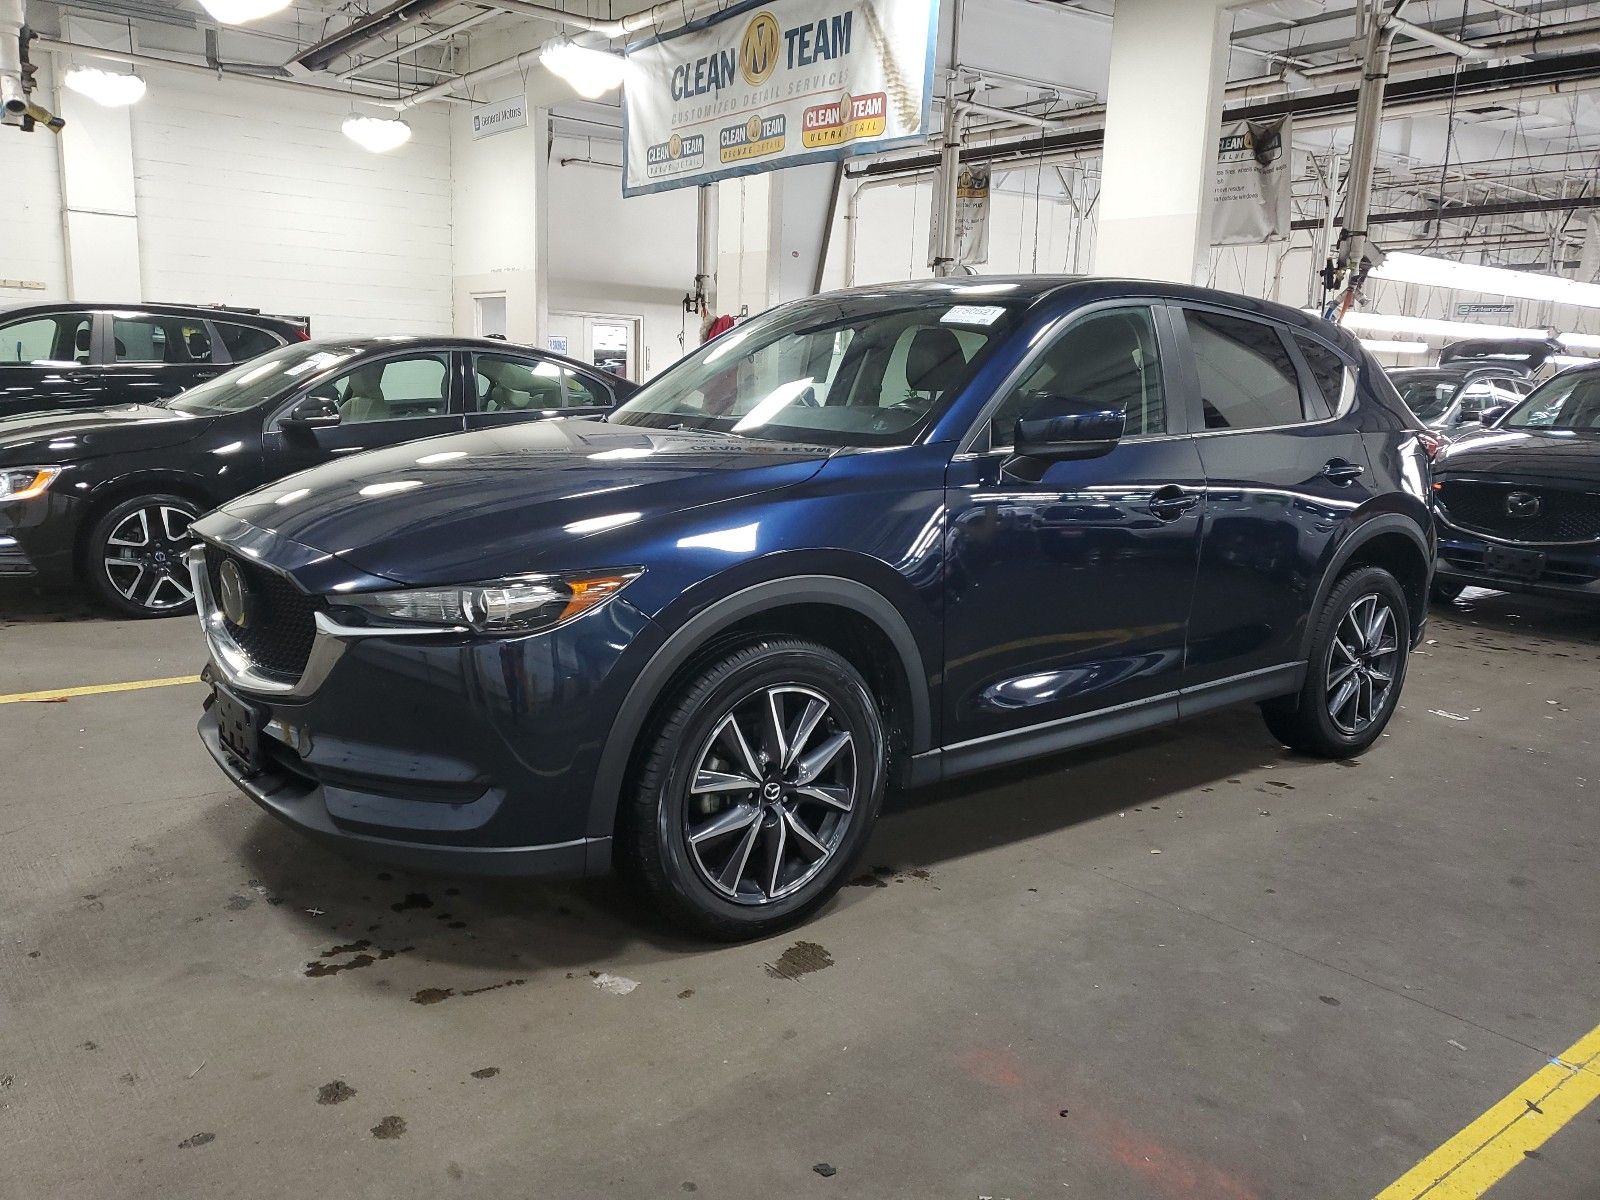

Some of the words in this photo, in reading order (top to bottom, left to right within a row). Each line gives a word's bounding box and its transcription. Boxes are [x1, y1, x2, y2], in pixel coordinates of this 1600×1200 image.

[671, 47, 736, 102] CLEAN
[784, 10, 853, 70] TEAM
[481, 111, 502, 127] General
[502, 107, 522, 121] Motors
[672, 98, 737, 125] CUSTOMIZED
[743, 87, 781, 107] DETAIL
[806, 107, 840, 128] CLEAN
[852, 97, 883, 118] TEAM
[721, 126, 746, 146] CLEAN
[762, 117, 784, 138] TEAM
[810, 130, 842, 142] ULTRA
[648, 144, 670, 163] CLEAN
[682, 137, 703, 155] TEAM
